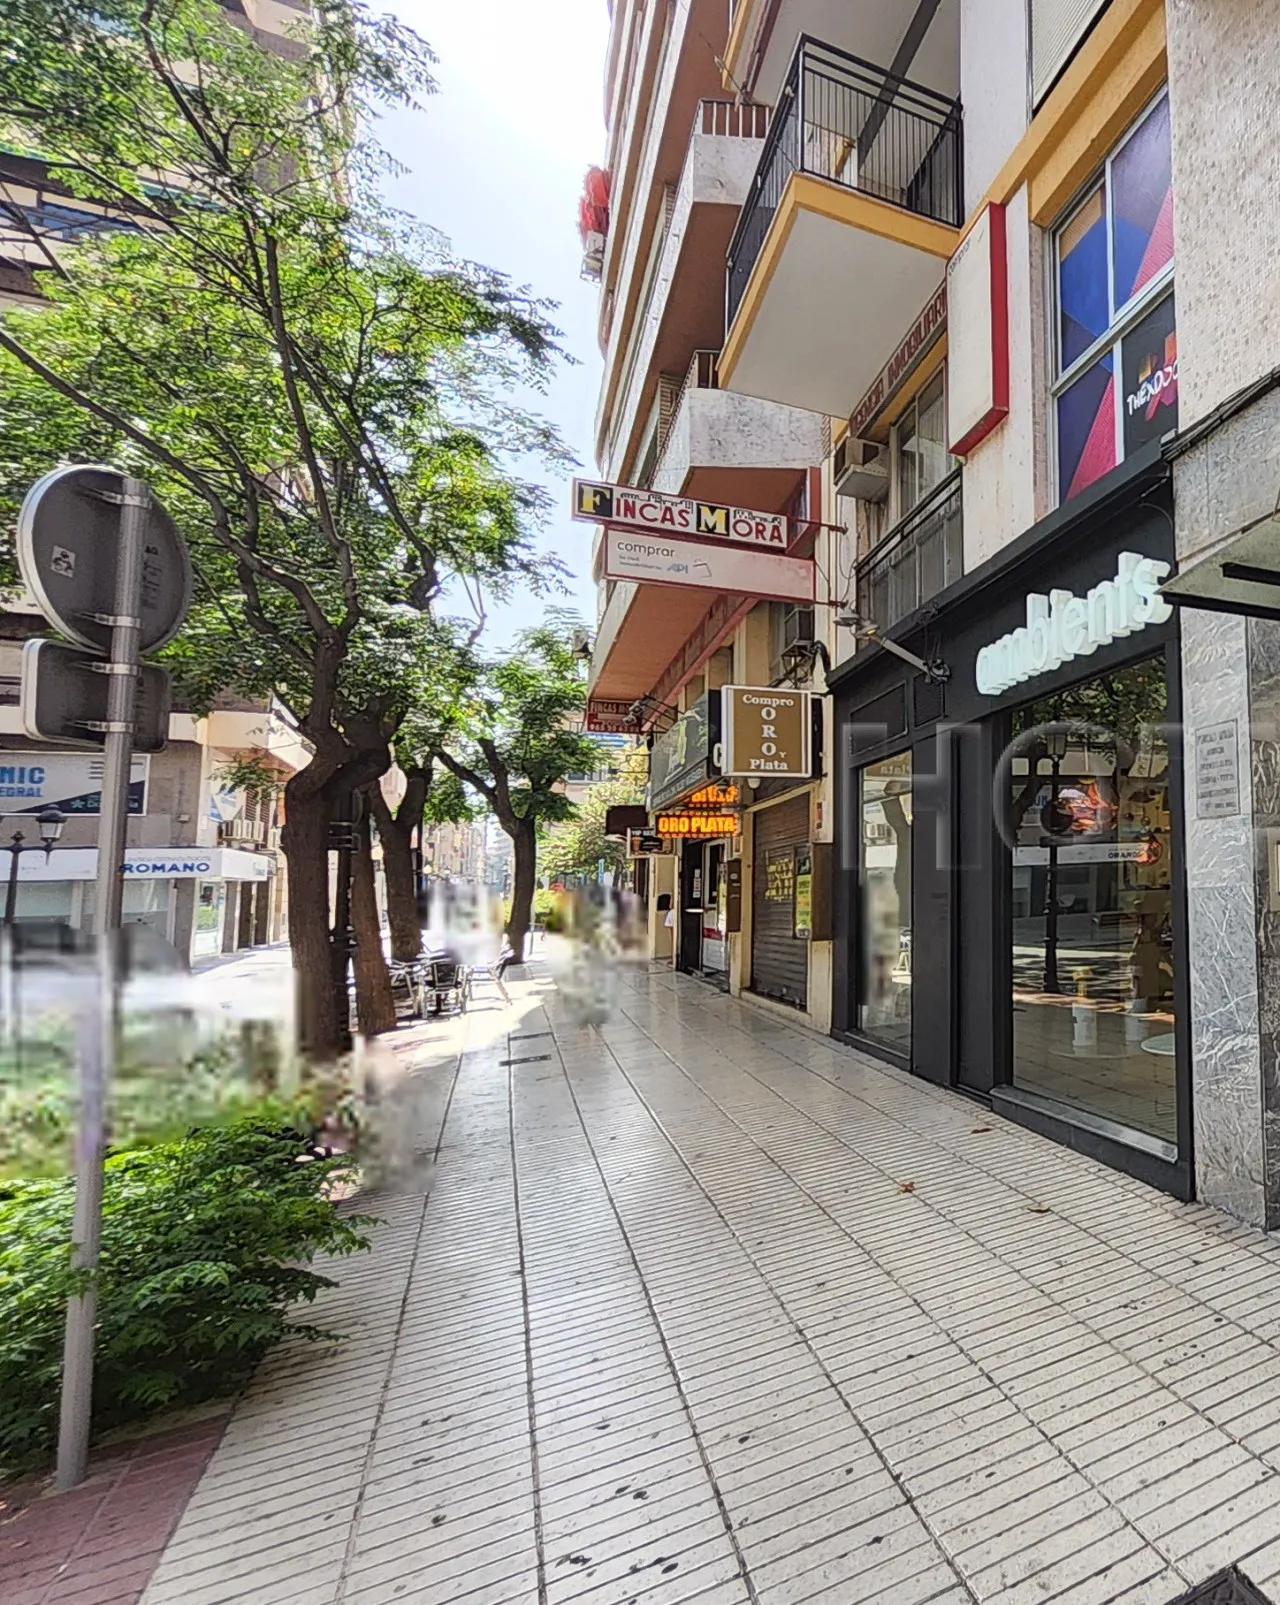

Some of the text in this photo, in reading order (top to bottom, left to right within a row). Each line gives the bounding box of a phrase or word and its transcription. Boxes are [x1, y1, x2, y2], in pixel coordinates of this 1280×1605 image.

[579, 483, 785, 546] FINCAS MORA
[616, 541, 676, 558] comprar
[975, 551, 1174, 696] ambients
[742, 694, 795, 708] Compro
[749, 758, 789, 771] Plata
[658, 816, 735, 833] ORO PLATA
[122, 862, 210, 874] ROMANO
